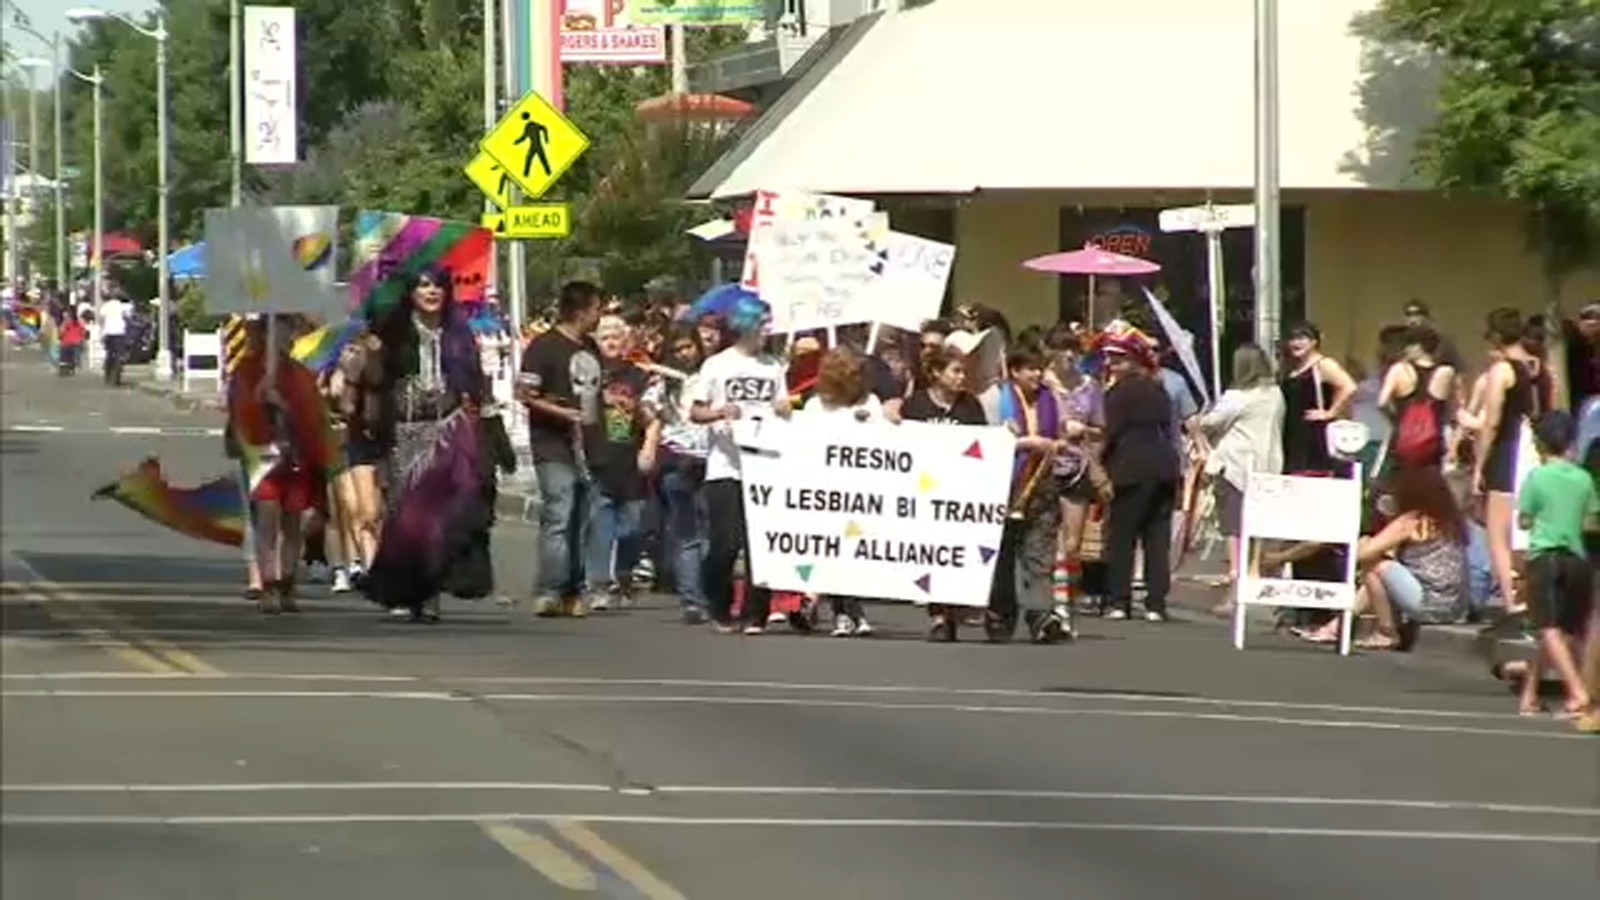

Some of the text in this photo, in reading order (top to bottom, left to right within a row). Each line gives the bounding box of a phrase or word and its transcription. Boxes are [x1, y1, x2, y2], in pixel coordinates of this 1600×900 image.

[611, 34, 657, 48] SHAKES
[512, 210, 561, 228] AHEAD
[1092, 232, 1151, 254] OPEN
[727, 380, 774, 399] GSA
[825, 444, 913, 473] FRESNO
[785, 488, 884, 515] LESBIAN
[897, 496, 917, 518] BI
[930, 499, 1007, 525] TRANS
[765, 531, 966, 567] YOUTH ALLIANCE
